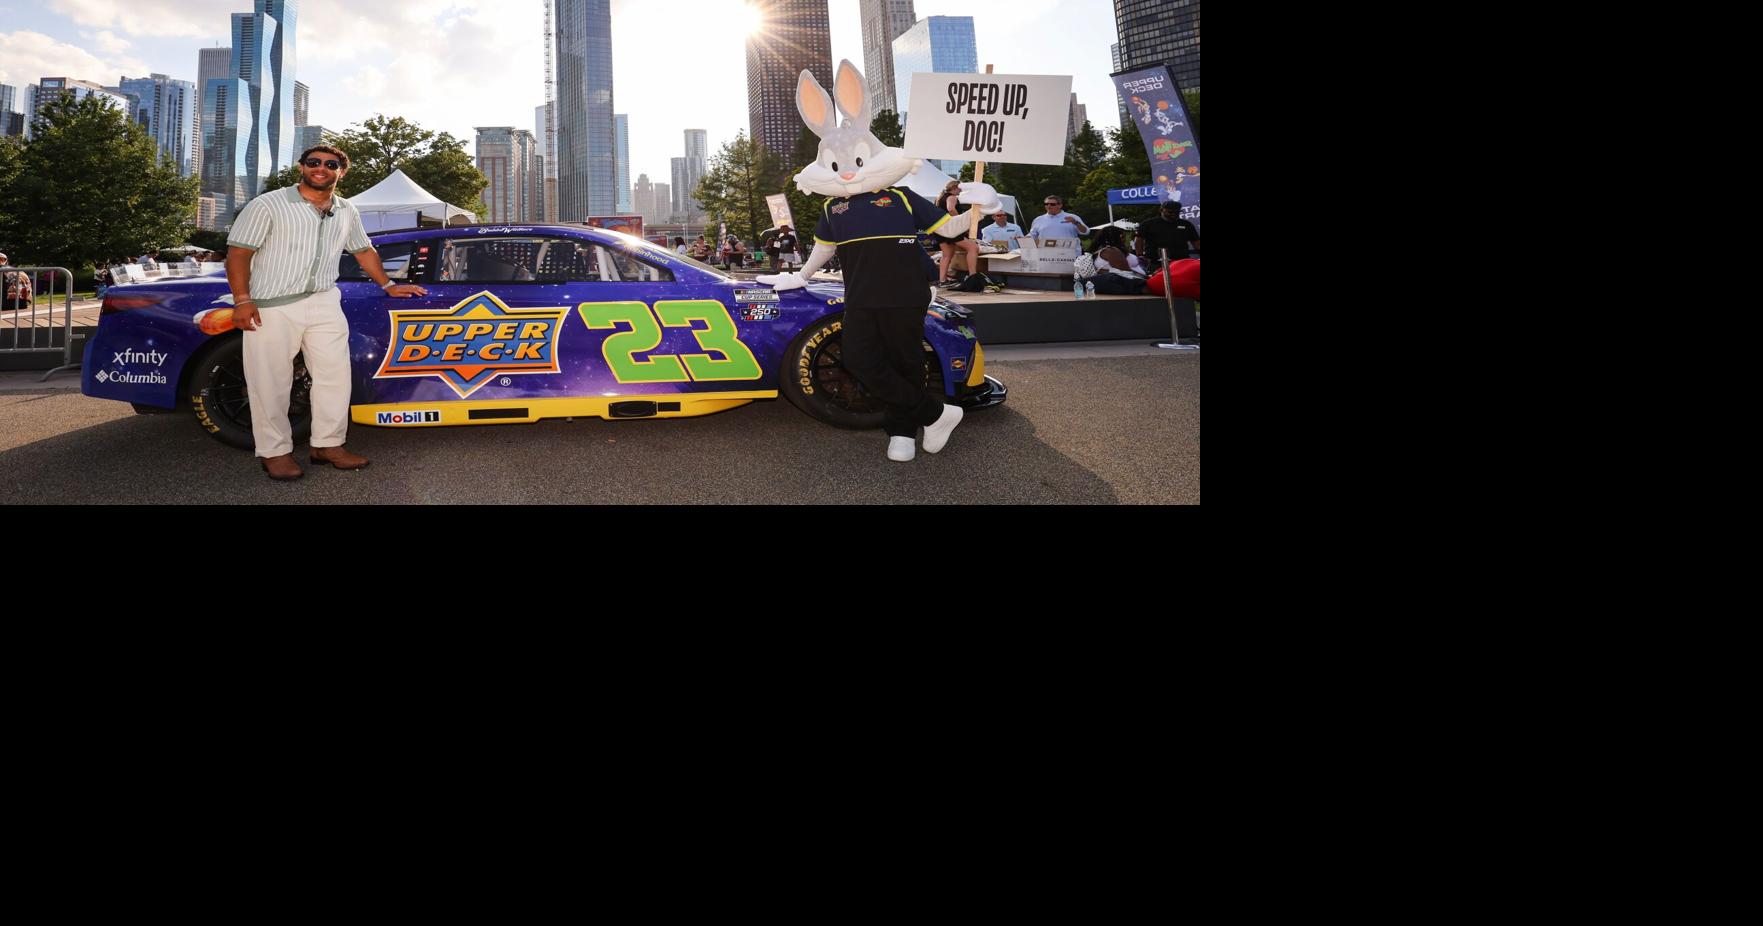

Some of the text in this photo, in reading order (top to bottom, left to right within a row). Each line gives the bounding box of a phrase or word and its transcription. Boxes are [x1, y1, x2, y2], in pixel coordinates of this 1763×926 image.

[945, 82, 1029, 120] SPEED UP,
[962, 119, 1005, 153] DOC!
[750, 308, 771, 316] 250
[402, 322, 550, 342] UPPER
[577, 299, 763, 384] 23
[112, 347, 168, 367] xfinity
[799, 321, 843, 395] GOODYEAR
[109, 370, 167, 384] Columbia
[192, 395, 220, 434] EAGLE
[378, 411, 422, 424] Mobil
